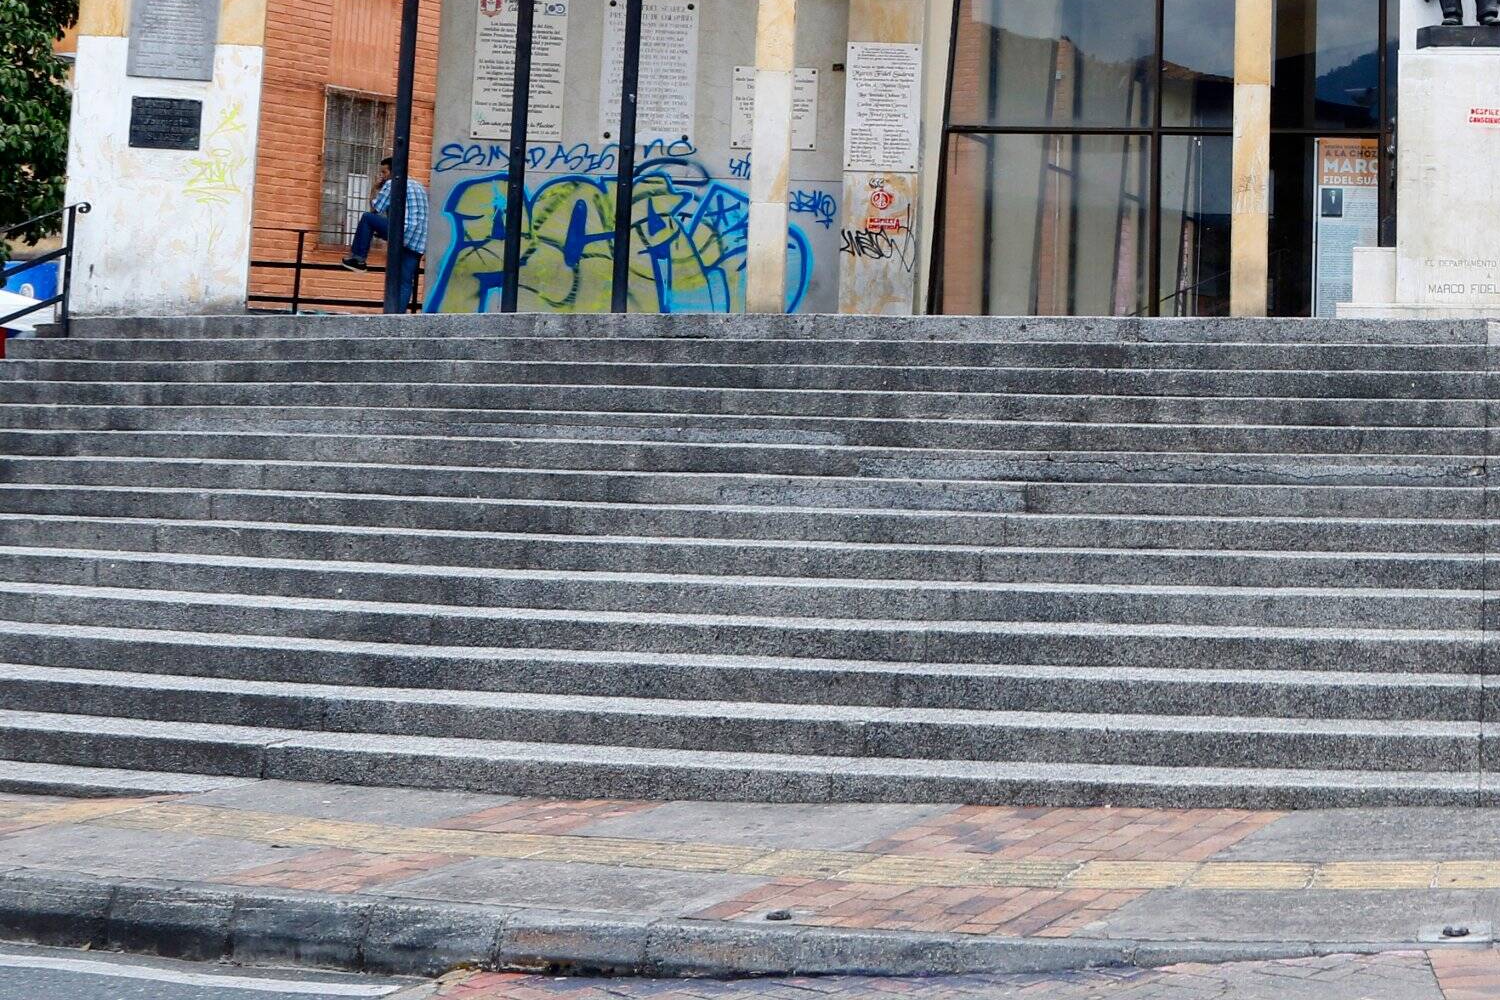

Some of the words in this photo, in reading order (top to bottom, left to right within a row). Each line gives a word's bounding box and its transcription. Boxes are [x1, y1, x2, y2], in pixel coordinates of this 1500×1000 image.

[1323, 175, 1354, 185] FIDEL
[1428, 283, 1465, 295] MARCO
[1470, 283, 1500, 295] FIDEL
